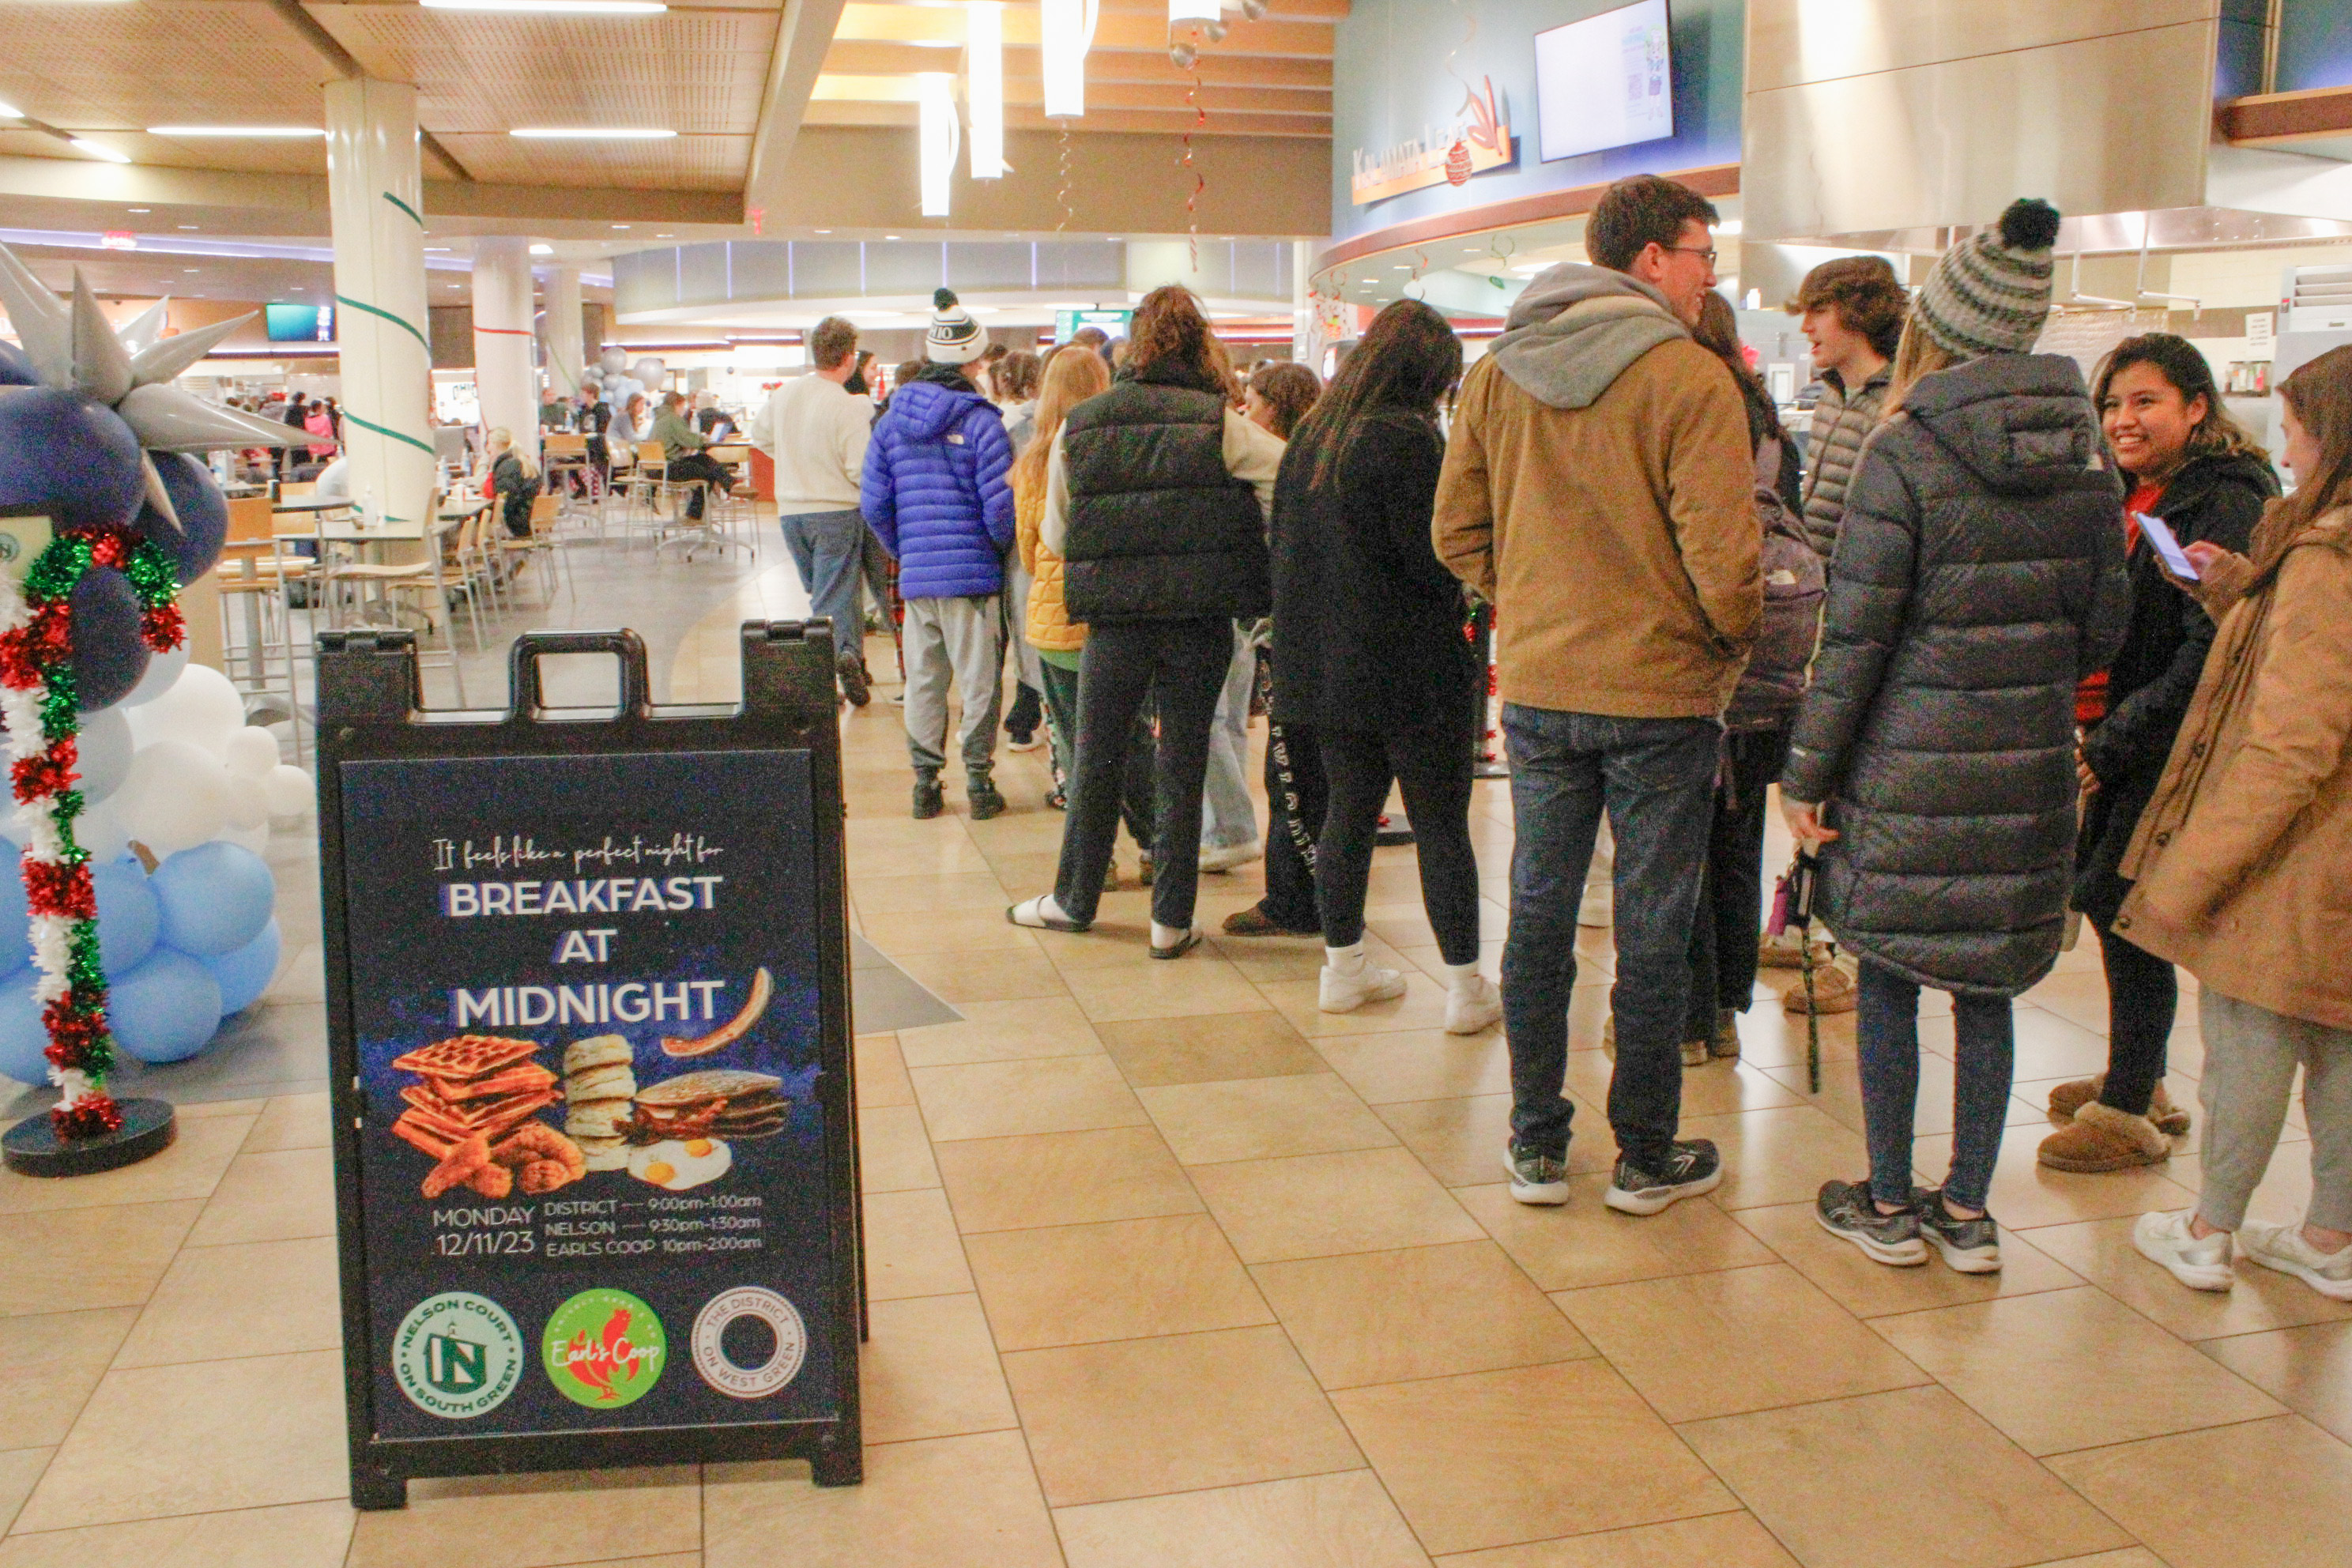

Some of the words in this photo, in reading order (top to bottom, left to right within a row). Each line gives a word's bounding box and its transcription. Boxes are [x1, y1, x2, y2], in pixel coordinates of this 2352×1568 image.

[432, 838, 456, 870] It
[464, 835, 511, 869] feels
[513, 834, 550, 869] like
[552, 850, 566, 859] a
[574, 835, 643, 874] perfect
[644, 832, 693, 866] night
[696, 835, 724, 864] for
[448, 876, 724, 918] BREAKFAST
[558, 928, 619, 963] AT
[456, 979, 726, 1028] MIDNIGHT
[432, 1205, 537, 1227] MONDAY
[544, 1199, 617, 1216] DISTRICT
[436, 1230, 535, 1256] 12/11/23
[545, 1220, 616, 1236] NELSON
[605, 1238, 657, 1255] COOP
[401, 1298, 459, 1349] NELSON
[463, 1300, 513, 1342] COURT
[706, 1303, 729, 1327] THE
[730, 1296, 790, 1324] DISTRICT
[552, 1339, 610, 1367] Earl's
[612, 1336, 661, 1372] Coop
[703, 1346, 719, 1367] ON
[718, 1367, 757, 1388] WEST
[762, 1341, 795, 1383] GREEN
[400, 1363, 416, 1388] ON
[414, 1387, 473, 1413] SOUTH
[476, 1358, 517, 1408] GREEN
